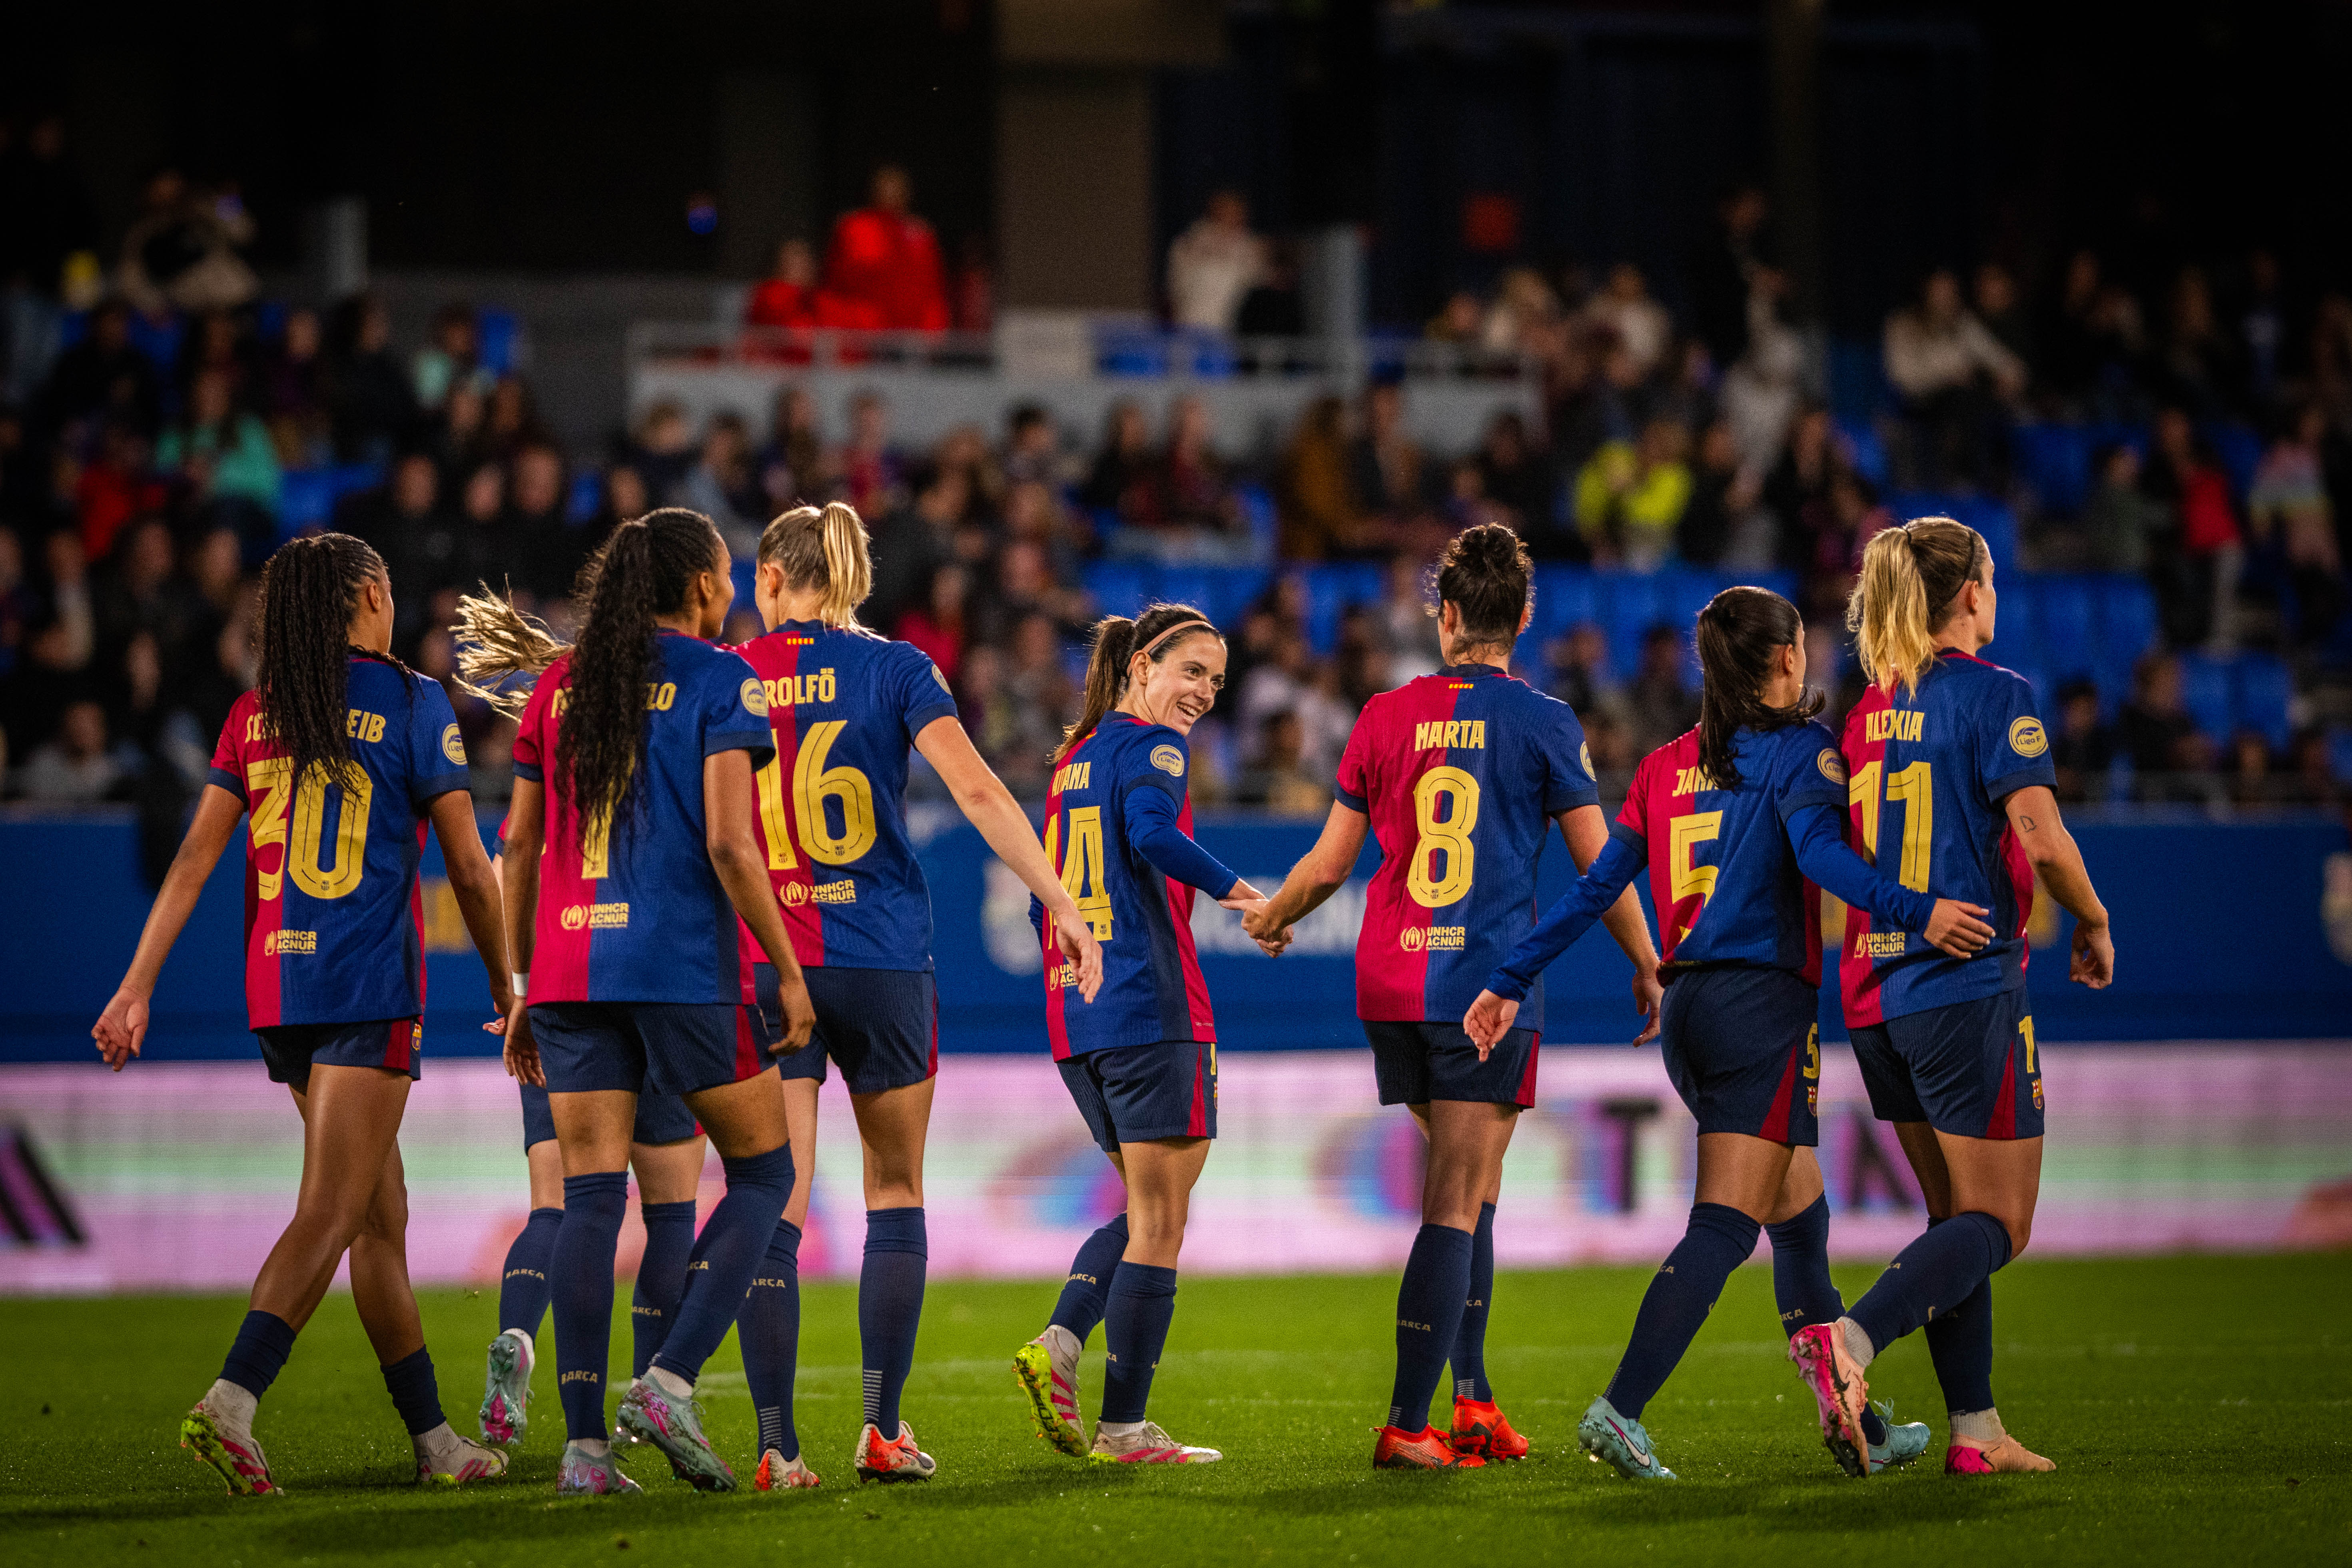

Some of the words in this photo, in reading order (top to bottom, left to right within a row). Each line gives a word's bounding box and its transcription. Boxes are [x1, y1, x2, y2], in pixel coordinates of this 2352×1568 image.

[762, 668, 836, 708] ROLFÖ
[1415, 720, 1485, 752] MARTA
[1866, 709, 1925, 744] ALEXIA
[756, 720, 877, 870] 16
[1051, 761, 1091, 798] AITANA
[247, 756, 373, 901] 30
[1406, 765, 1480, 908] 8
[1849, 761, 1933, 893] 11
[810, 880, 854, 893] UNHCR
[1045, 806, 1115, 950] 14
[1670, 810, 1723, 943] 5
[589, 903, 629, 914] UNHCR
[810, 889, 856, 901] ACNUR
[588, 913, 628, 924] ACNUR
[1426, 926, 1465, 936] UNHCR
[277, 930, 317, 940] UNHCR
[277, 939, 316, 950] ACNUR
[1426, 936, 1465, 946] ACNUR
[1866, 932, 1905, 943] UNHCR
[1868, 942, 1905, 953] ACNUR
[1803, 1022, 1820, 1079] 5
